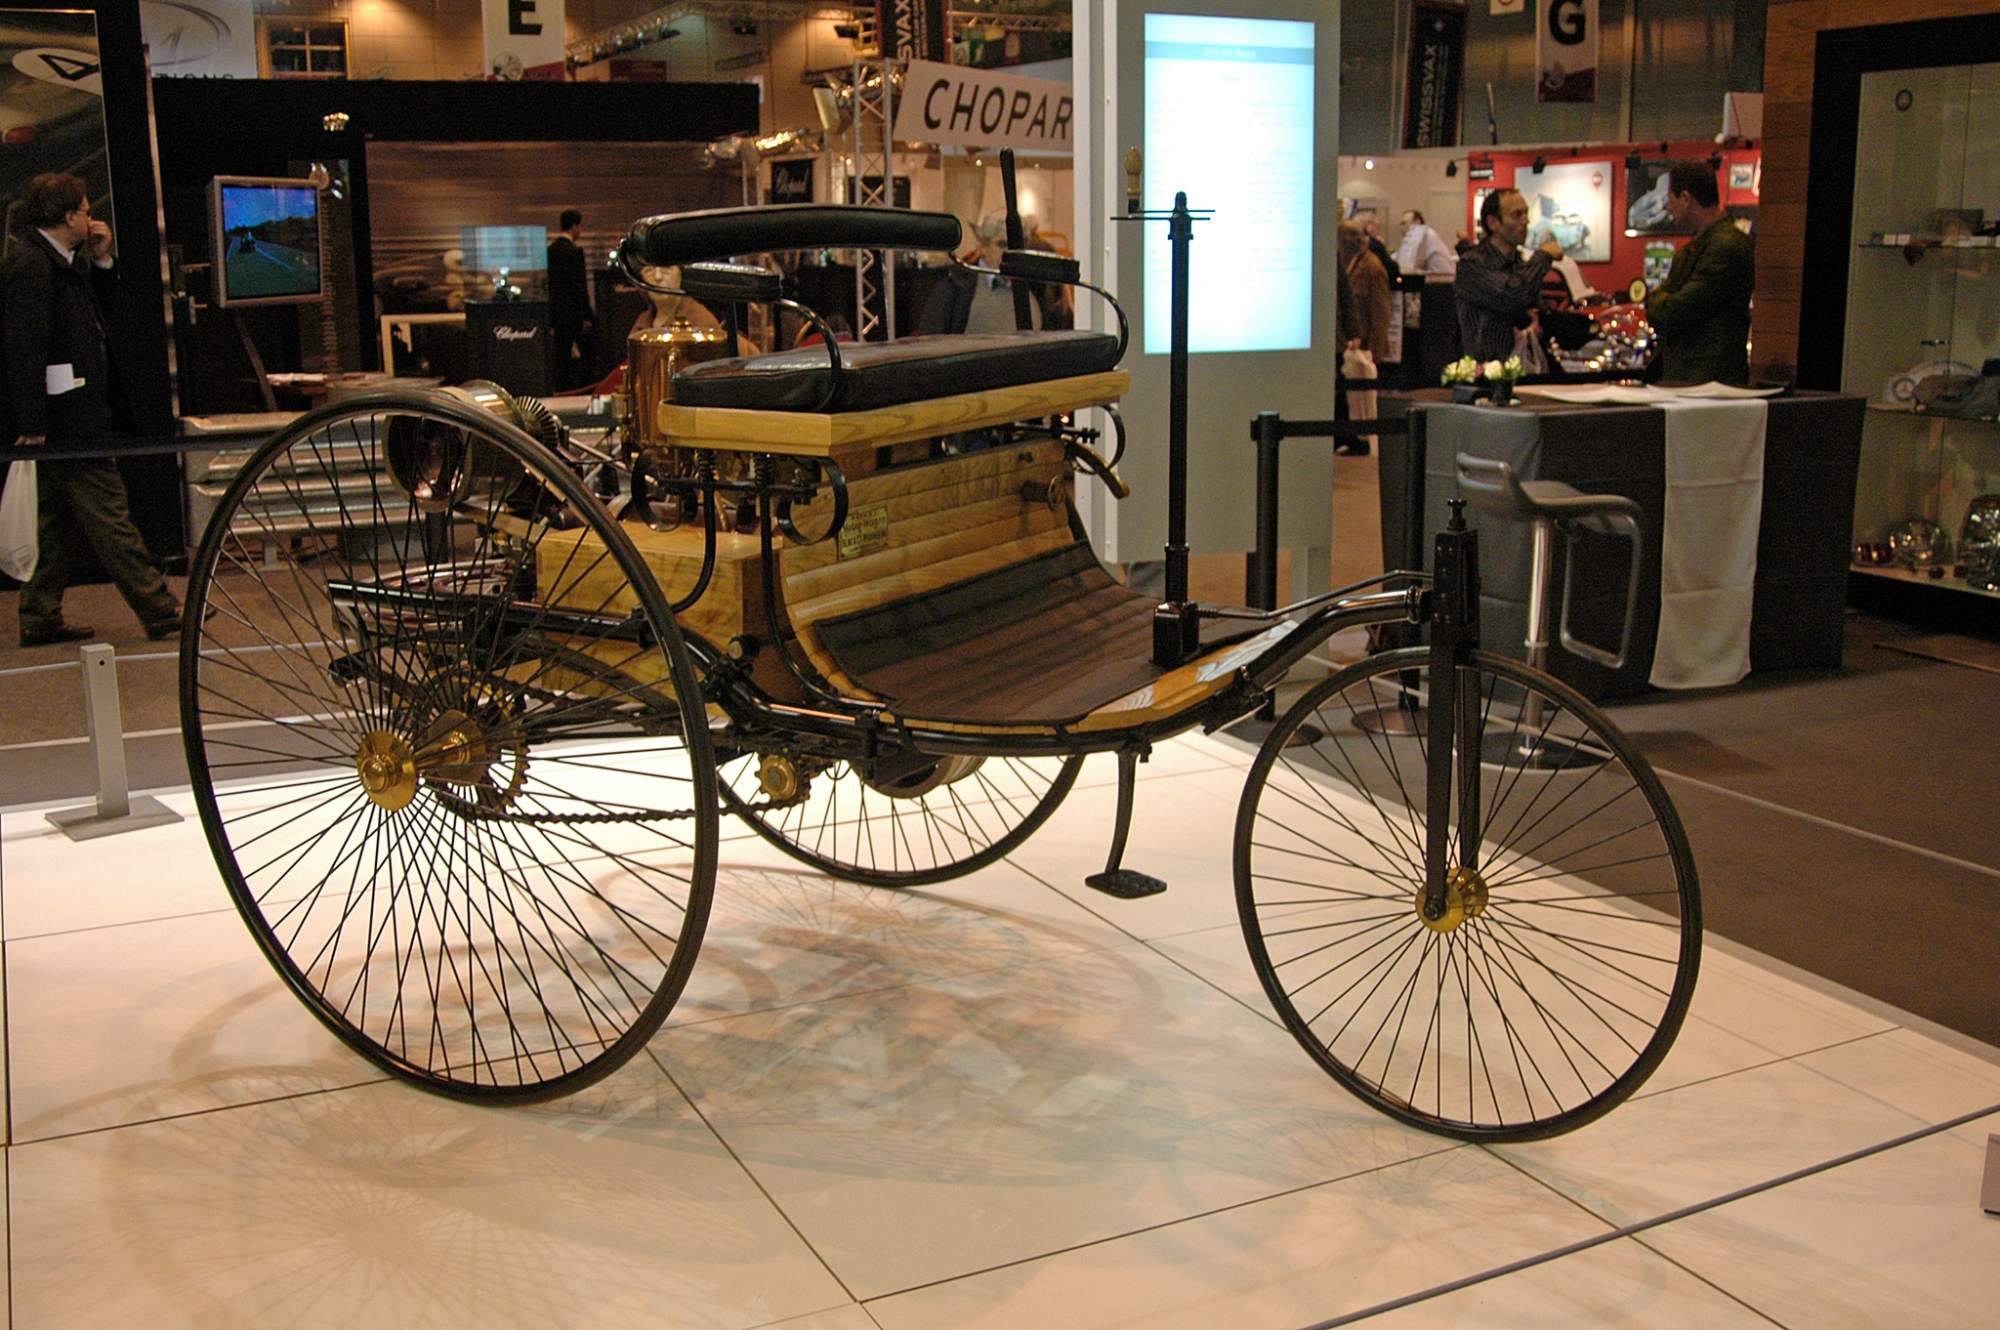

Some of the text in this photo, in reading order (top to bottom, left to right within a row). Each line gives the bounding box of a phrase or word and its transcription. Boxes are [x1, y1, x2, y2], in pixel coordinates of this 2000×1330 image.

[509, 0, 543, 35] E
[1549, 0, 1587, 45] G
[1417, 44, 1438, 147] SWISSVAX
